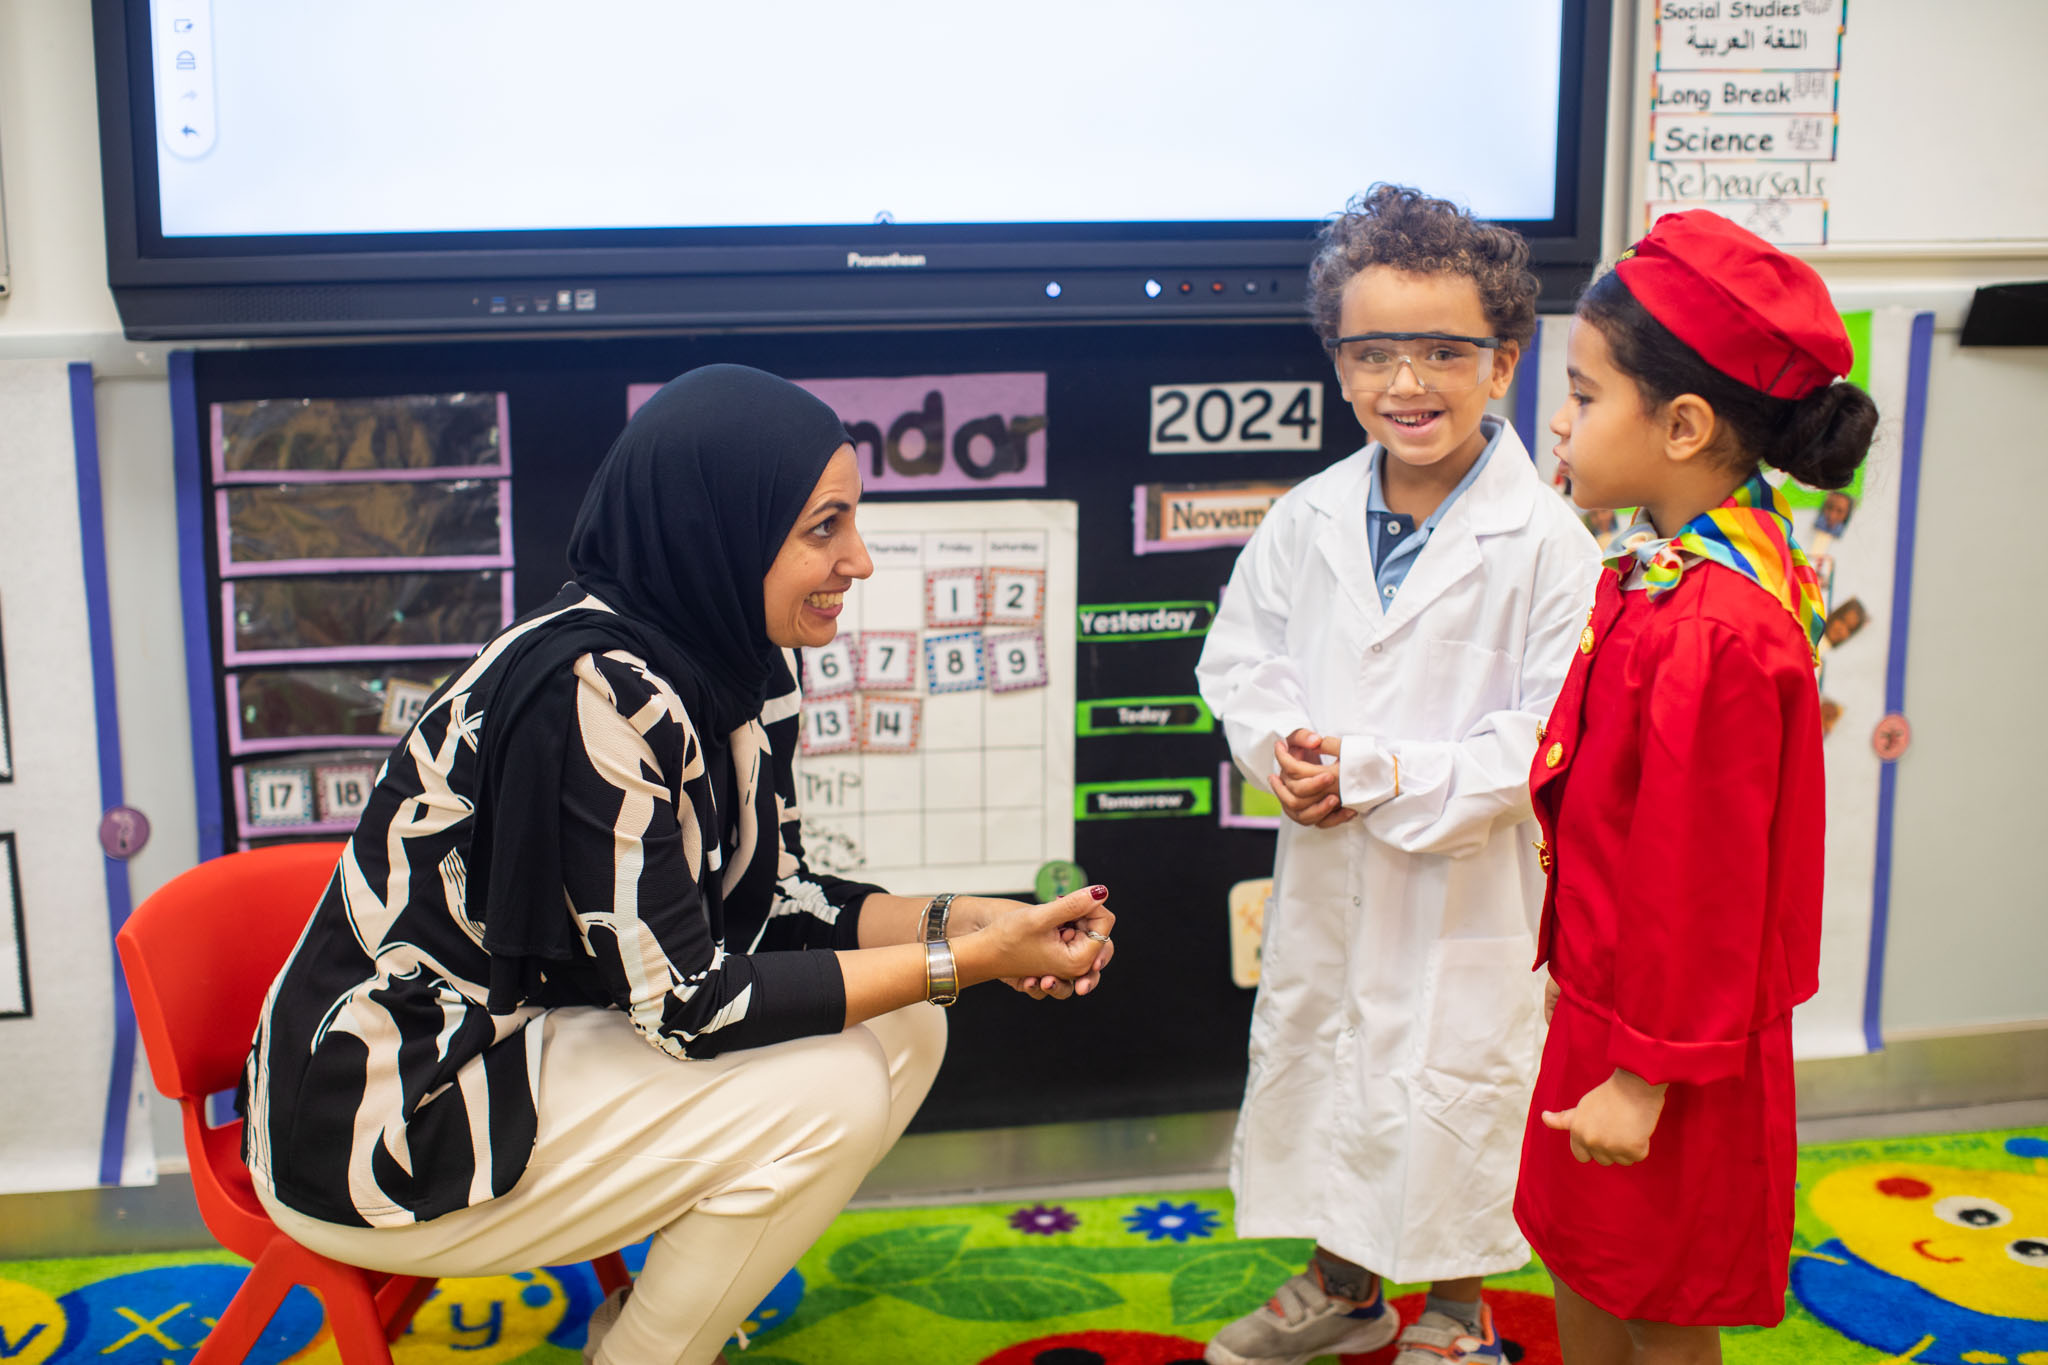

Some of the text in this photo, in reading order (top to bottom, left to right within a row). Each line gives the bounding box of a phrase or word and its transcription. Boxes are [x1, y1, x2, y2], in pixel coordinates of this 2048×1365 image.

[1663, 0, 1801, 20] Social Studies
[1687, 25, 1807, 56] اللغة العربية
[1659, 82, 1791, 110] Long Break
[1665, 127, 1774, 151] Science
[1657, 161, 1825, 202] Rehearsals
[1156, 388, 1316, 443] 2024
[1172, 498, 1278, 531] Novem
[951, 584, 1024, 613] 1 2
[1080, 608, 1196, 634] Yesterday
[820, 647, 1026, 678] 6 7 8 9
[815, 711, 901, 736] 13 14
[1118, 707, 1170, 726] Today
[269, 781, 361, 809] 17 18
[1098, 794, 1184, 811] Tomorrow
